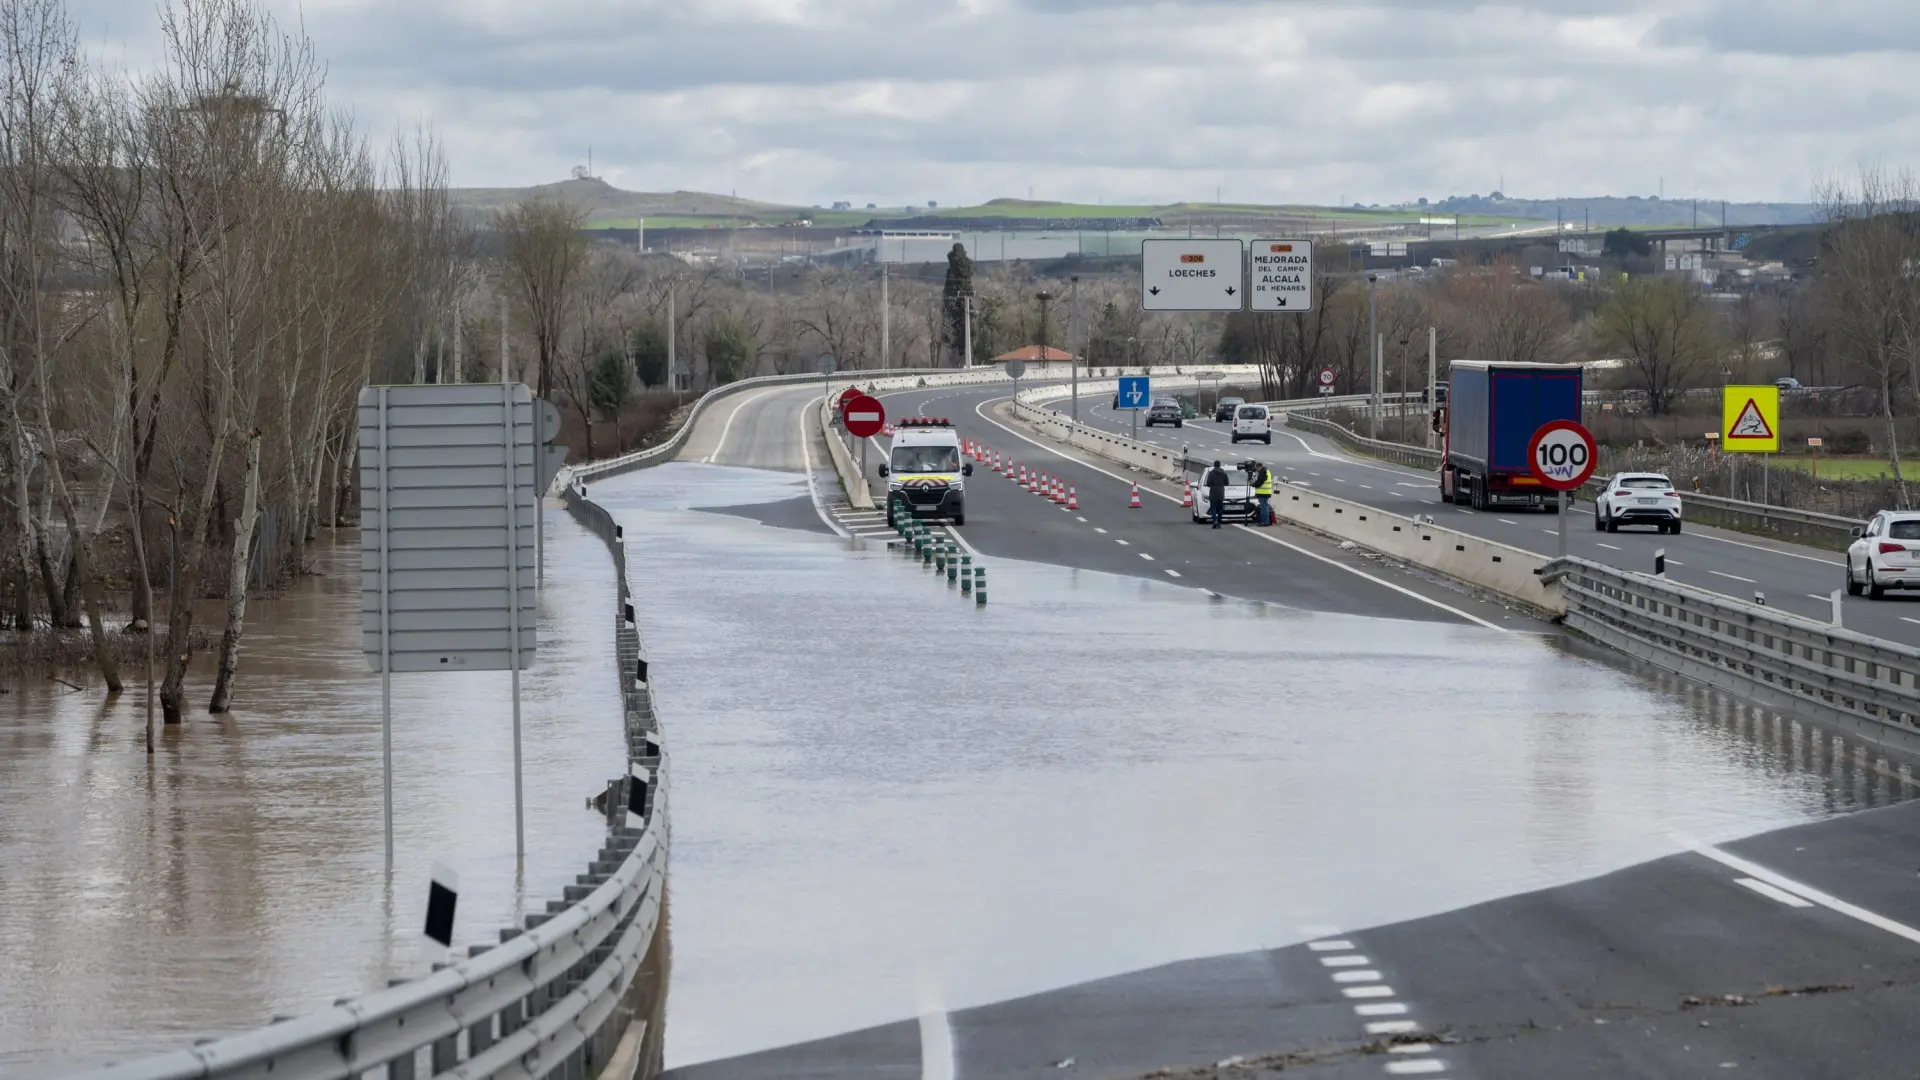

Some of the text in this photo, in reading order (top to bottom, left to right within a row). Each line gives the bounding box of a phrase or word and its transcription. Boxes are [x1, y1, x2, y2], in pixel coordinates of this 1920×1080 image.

[1169, 269, 1216, 277] LOECHES
[1262, 273, 1300, 283] ALCALÁ
[1539, 443, 1587, 466] 100
